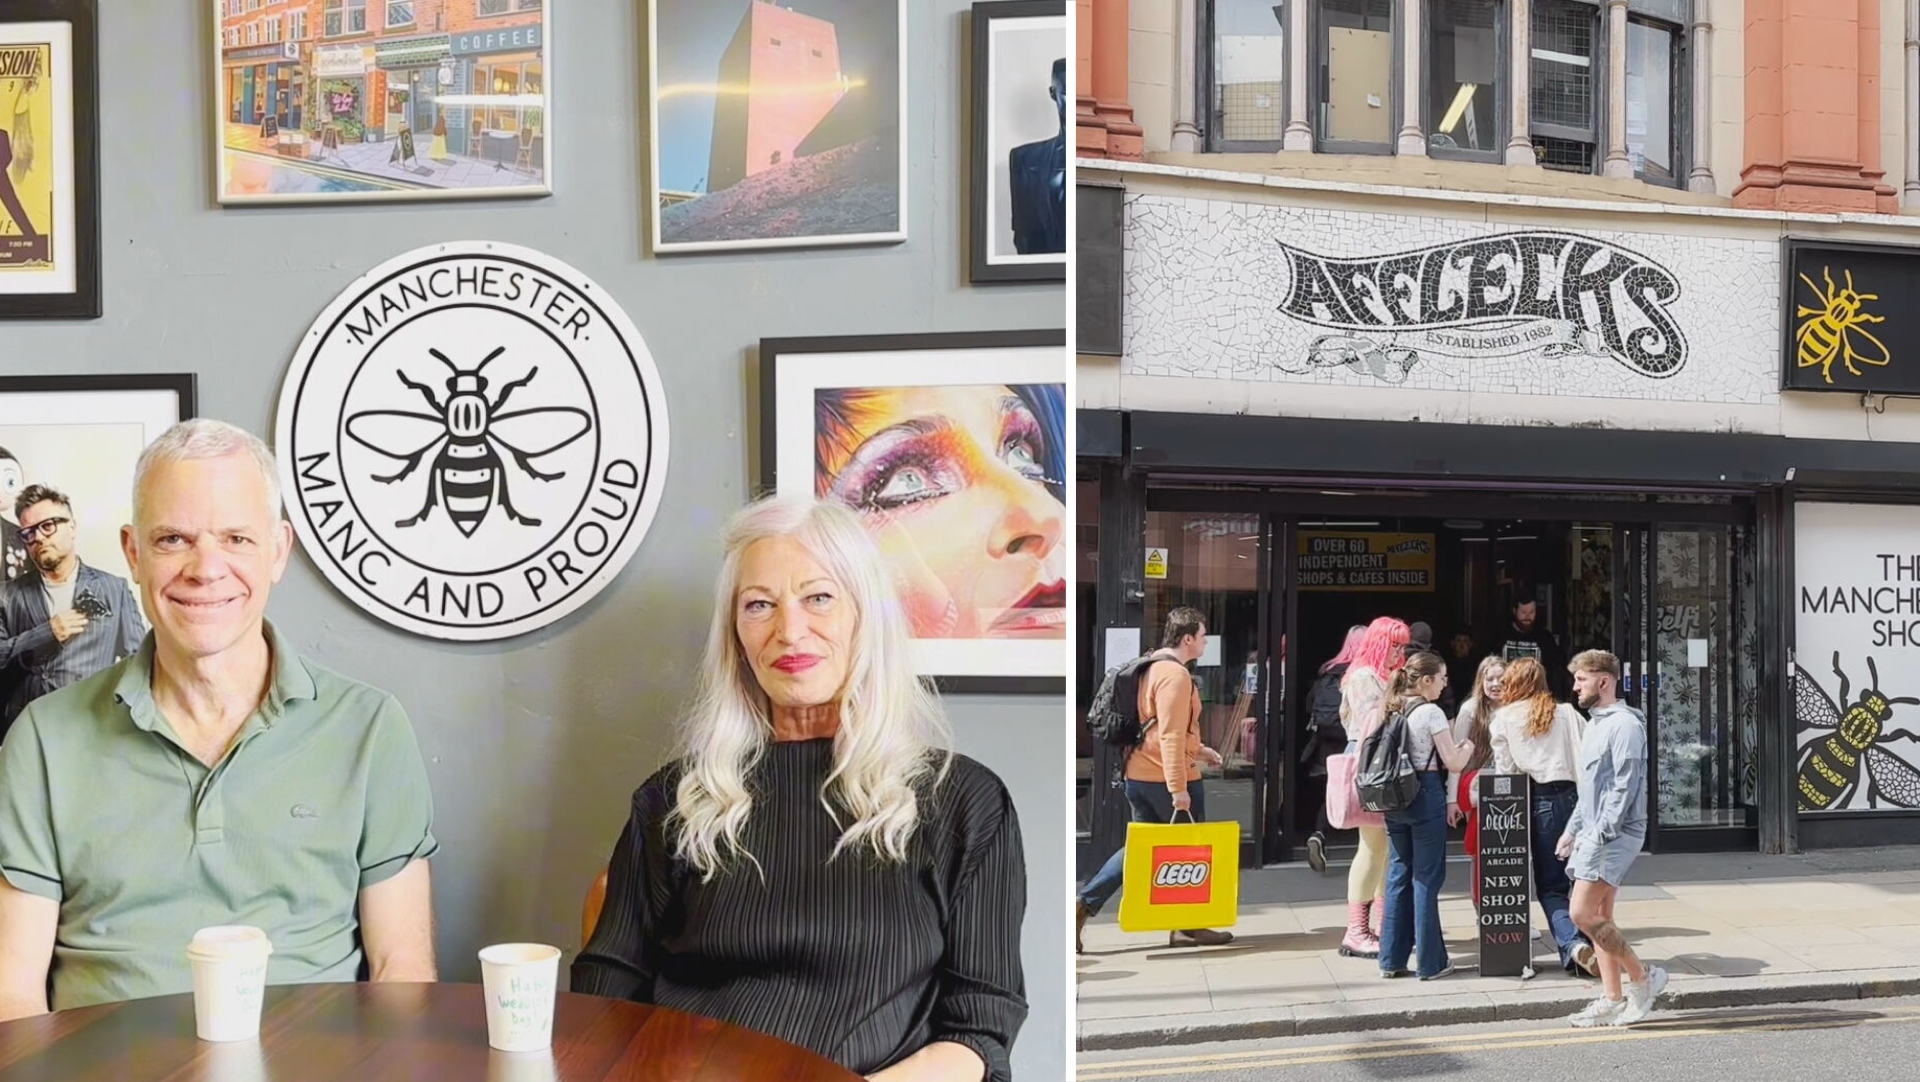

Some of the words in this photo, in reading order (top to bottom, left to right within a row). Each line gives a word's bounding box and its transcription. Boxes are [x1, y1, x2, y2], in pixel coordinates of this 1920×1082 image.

[461, 29, 535, 50] COFFEE
[0, 50, 36, 75] SION
[345, 266, 590, 345] MANCHESTER
[1285, 234, 1686, 374] AFFLECKS
[1425, 330, 1520, 350] ESTABLISHED
[1524, 325, 1553, 341] 1982
[298, 452, 391, 586] MANC
[404, 576, 504, 619] AND
[524, 458, 639, 602] PROUD
[1314, 538, 1346, 552] OVER
[1350, 539, 1365, 553] 60
[1299, 554, 1384, 569] INDEPENDENT
[1298, 571, 1334, 584] SHOPS
[1337, 572, 1346, 584] &
[1350, 571, 1384, 584] CAFES
[1388, 571, 1426, 584] INSIDE
[1485, 811, 1523, 831] OCCULT
[1481, 846, 1527, 855] AFFLECKS
[1486, 858, 1524, 866] ARCADE
[1155, 862, 1208, 886] LEGO
[1484, 876, 1523, 888] NEW
[1482, 894, 1526, 907] SHOP
[1481, 913, 1527, 925] OPEN
[1485, 932, 1523, 944] NOW
